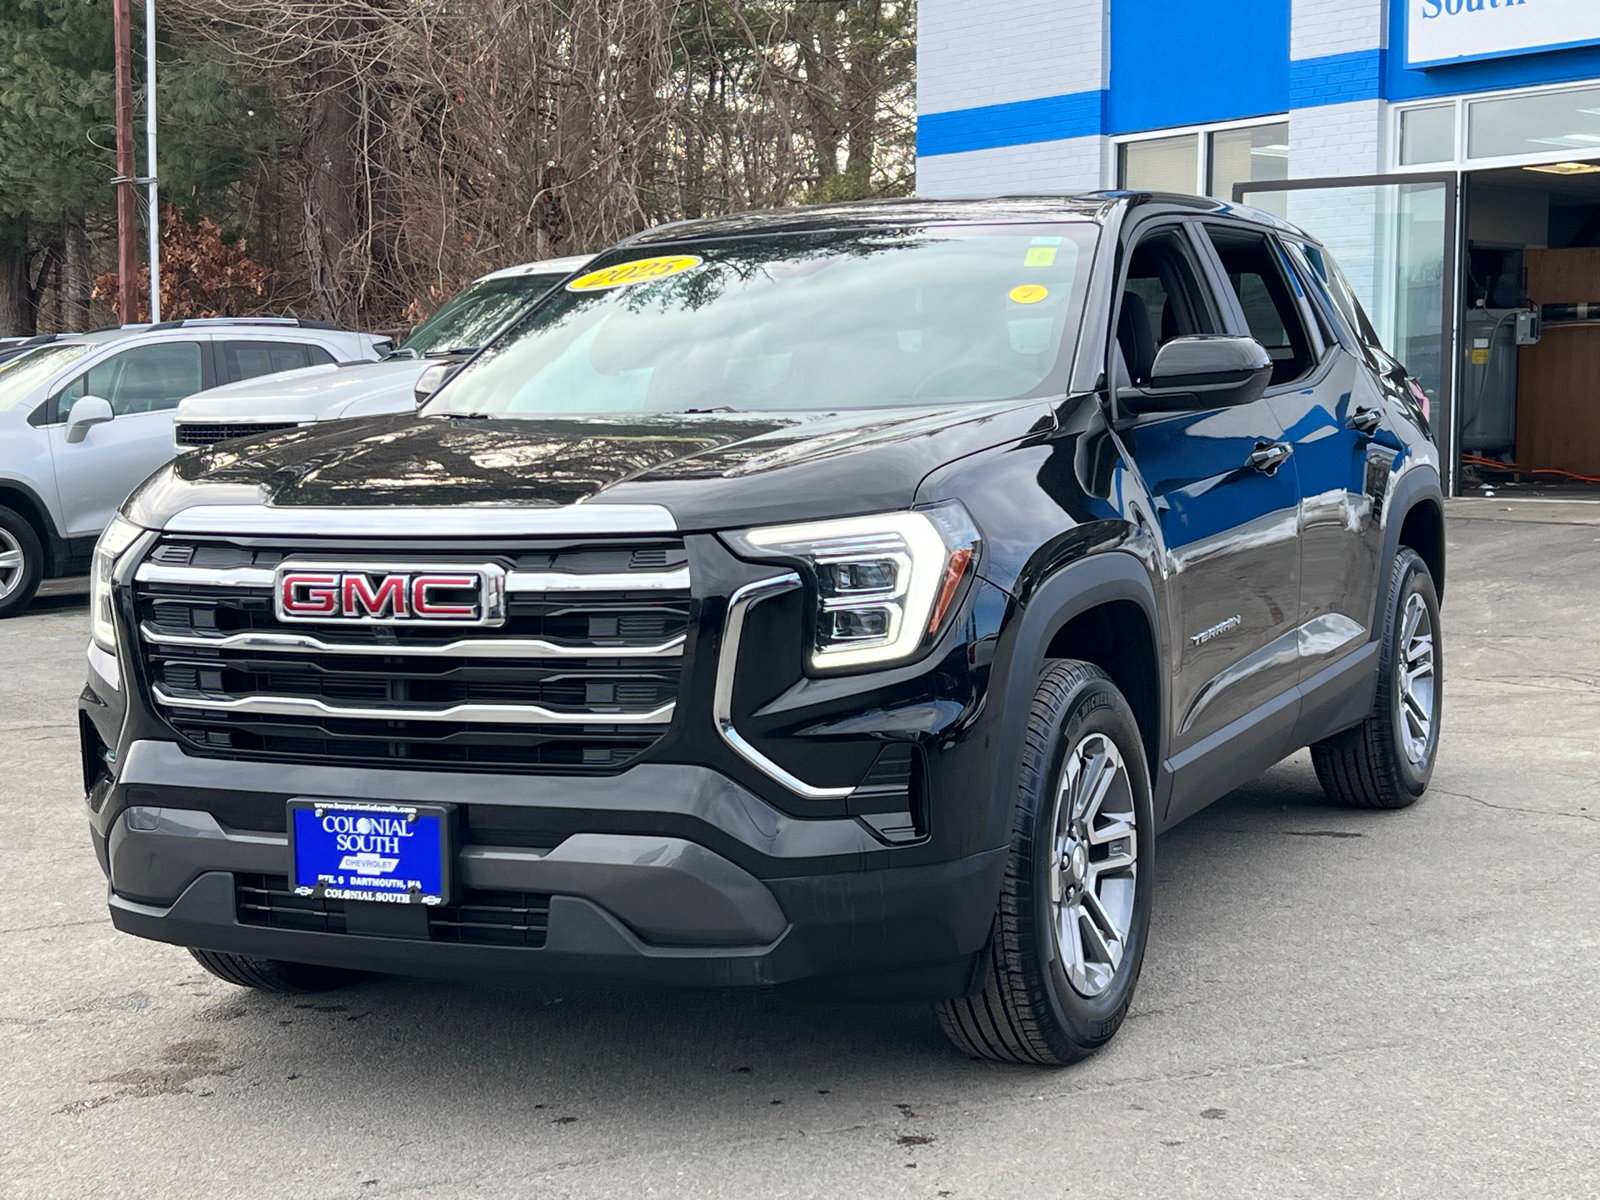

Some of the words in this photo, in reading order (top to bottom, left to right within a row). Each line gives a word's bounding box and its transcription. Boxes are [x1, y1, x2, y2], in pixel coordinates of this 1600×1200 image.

[1422, 0, 1526, 19] Sou
[584, 258, 686, 288] 2025
[281, 573, 479, 619] GMC
[1190, 614, 1241, 646] TERRAIN
[322, 815, 414, 837] COLONIAL
[336, 834, 400, 854] SOUTH
[345, 857, 392, 869] CHEVROLET
[349, 876, 407, 890] DARTMOUTH,
[324, 888, 375, 902] COLONIAL
[375, 892, 411, 904] SOUTH
